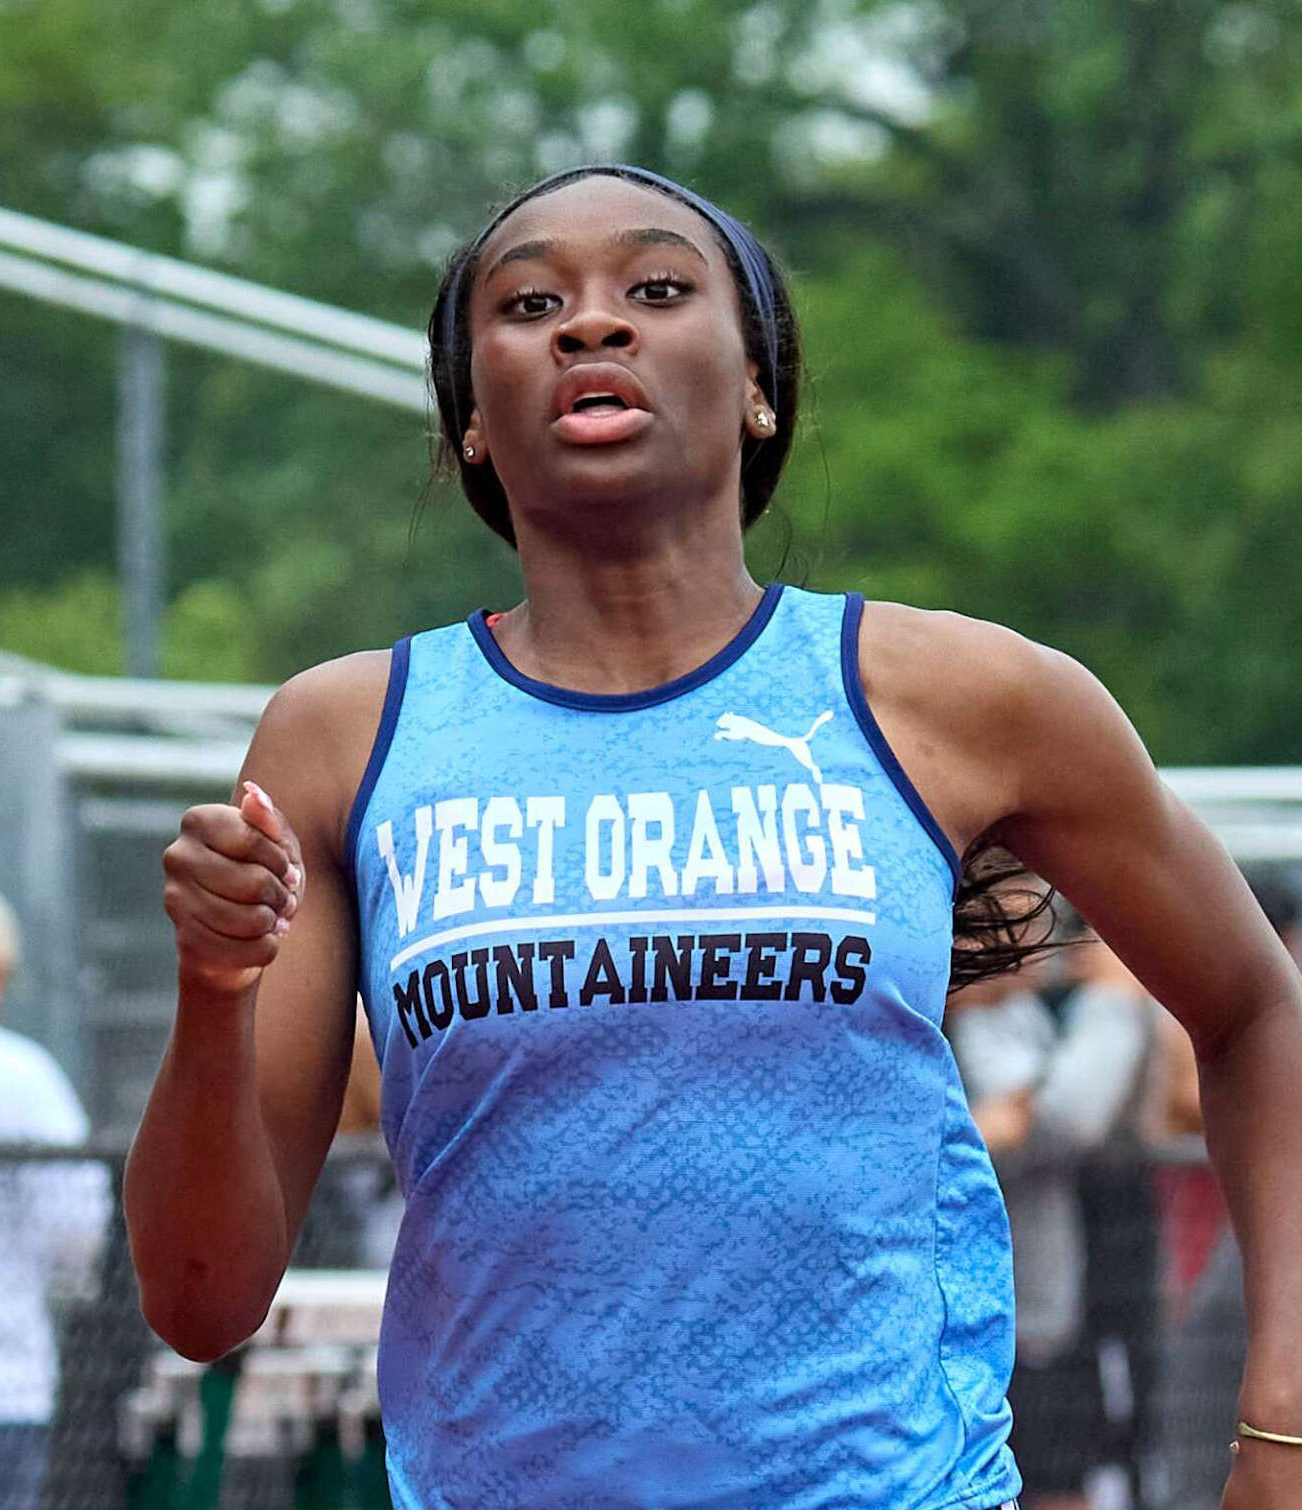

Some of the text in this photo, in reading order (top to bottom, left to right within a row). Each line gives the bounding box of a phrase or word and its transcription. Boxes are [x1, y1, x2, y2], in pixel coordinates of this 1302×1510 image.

[376, 783, 877, 939] WEST ORANGE
[392, 932, 872, 1050] MOUNTAINEERS
